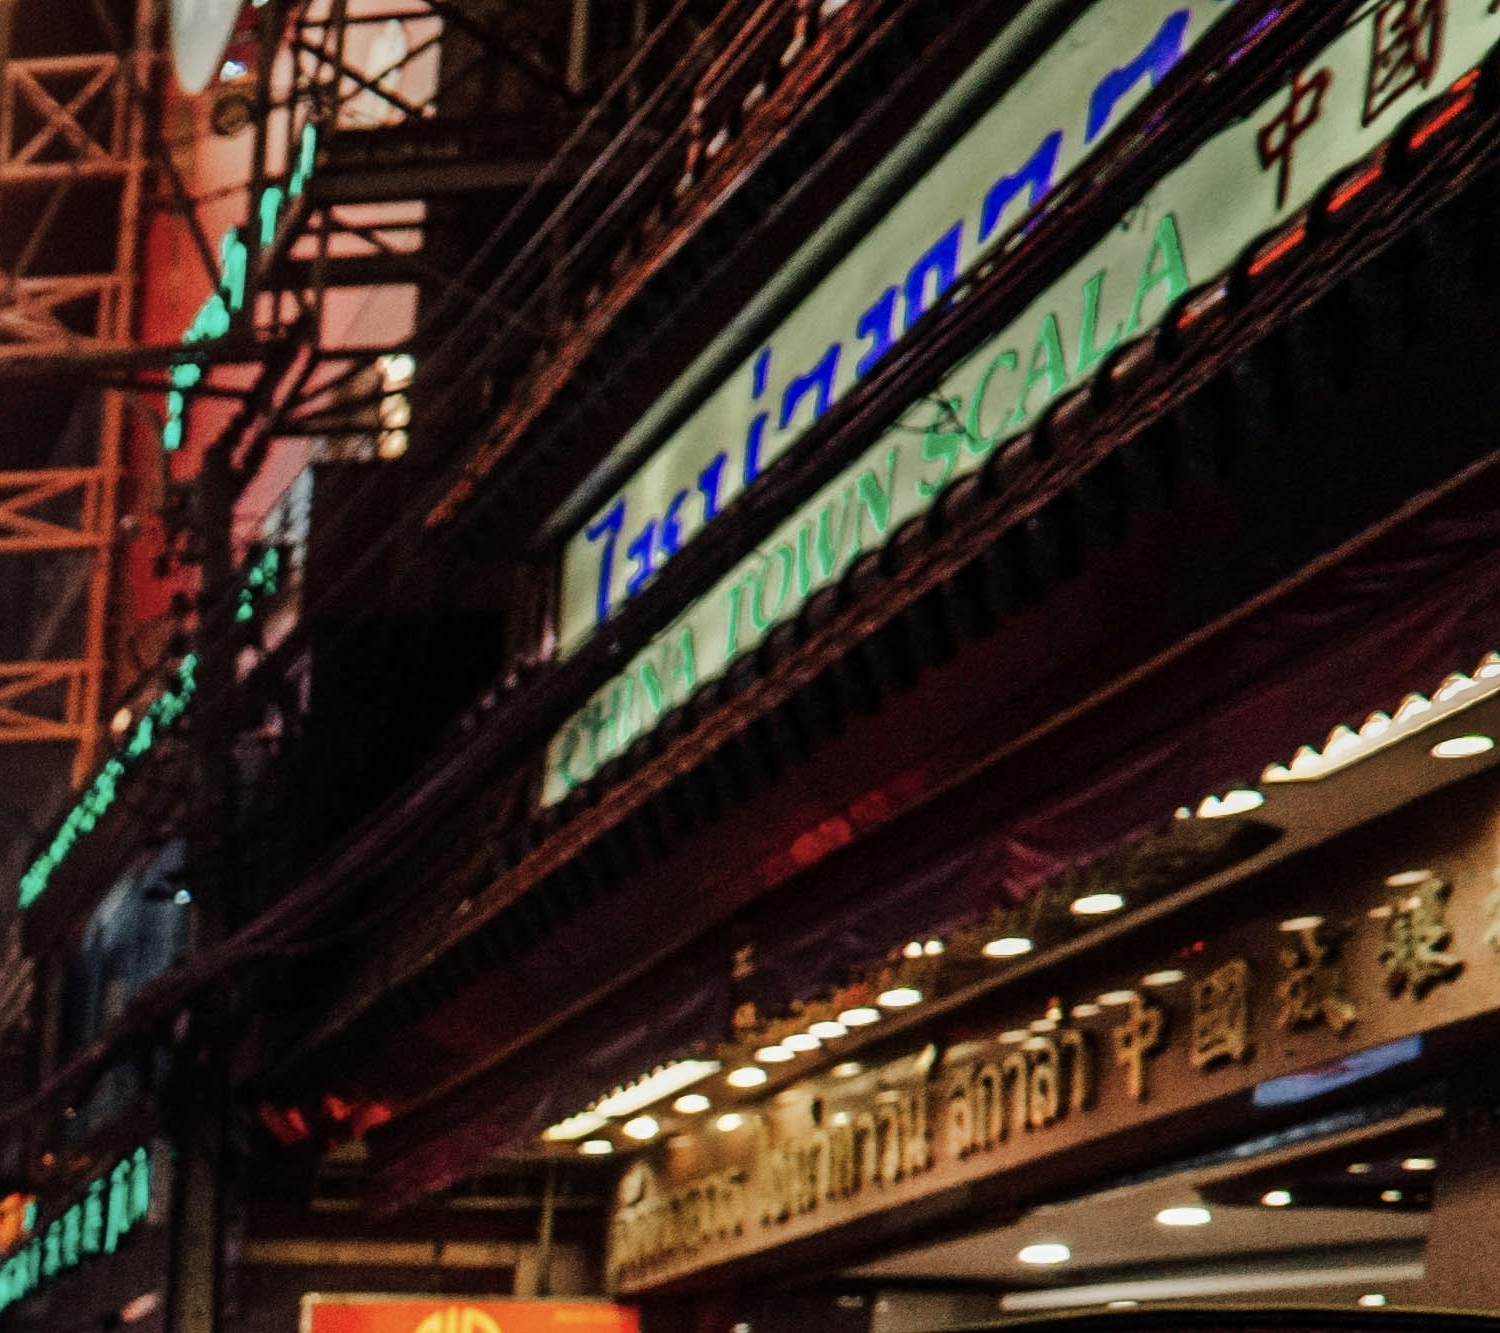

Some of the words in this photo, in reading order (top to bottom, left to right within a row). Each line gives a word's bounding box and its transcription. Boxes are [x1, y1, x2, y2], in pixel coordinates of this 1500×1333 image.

[561, 625, 696, 788] CHINA
[724, 458, 898, 656] TOWN
[917, 212, 1190, 498] SCALA
